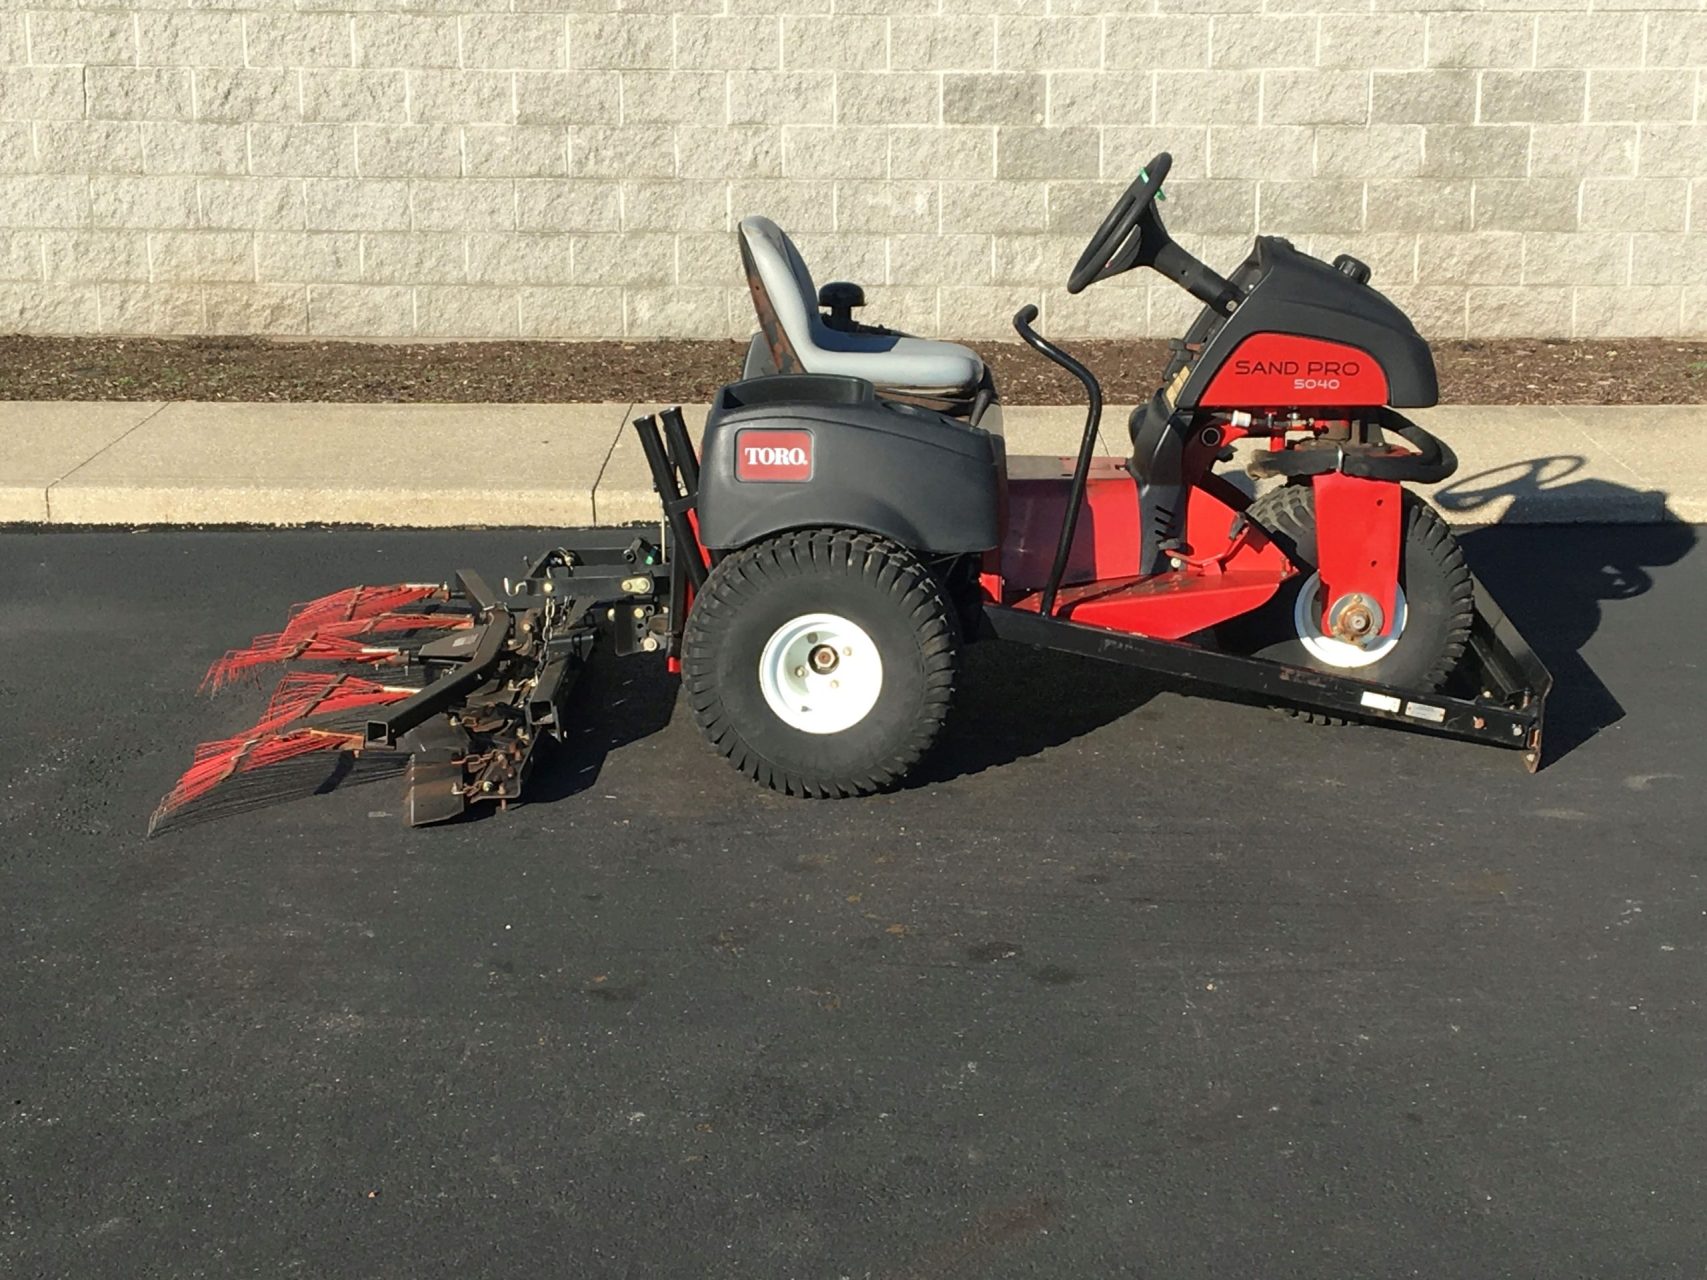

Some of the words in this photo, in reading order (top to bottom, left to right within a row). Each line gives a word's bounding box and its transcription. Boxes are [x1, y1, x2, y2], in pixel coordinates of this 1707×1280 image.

[1235, 360, 1299, 375] SAND
[1307, 361, 1360, 376] PRO
[1294, 378, 1340, 390] 5040
